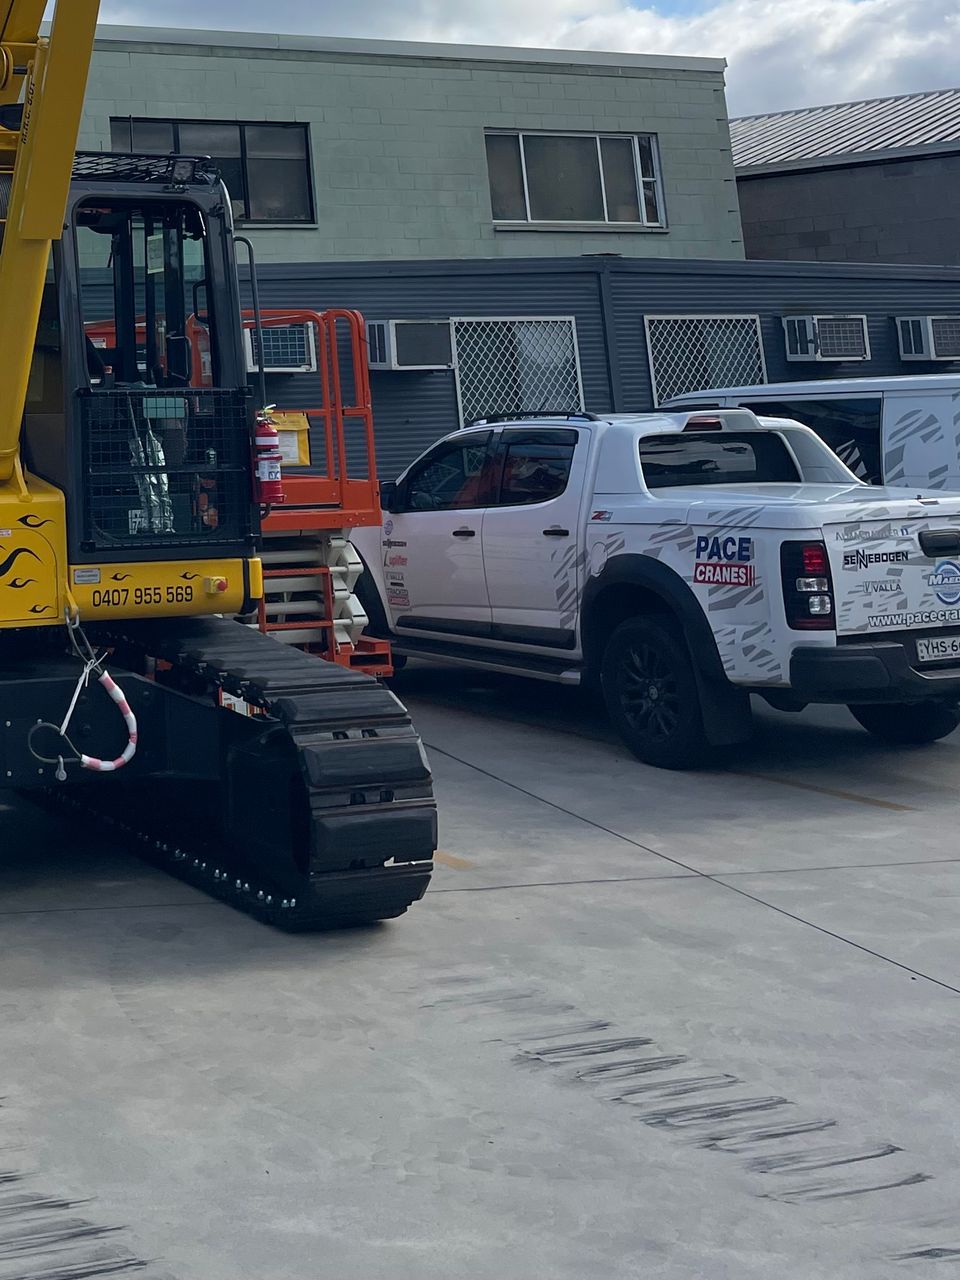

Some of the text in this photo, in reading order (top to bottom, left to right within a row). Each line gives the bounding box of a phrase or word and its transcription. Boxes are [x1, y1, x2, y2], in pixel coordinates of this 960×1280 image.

[696, 535, 752, 562] PACE
[843, 549, 909, 569] SENNEBOGEN
[695, 564, 747, 584] CRANES
[92, 585, 193, 608] 0407 955 569
[872, 582, 902, 593] VALLA
